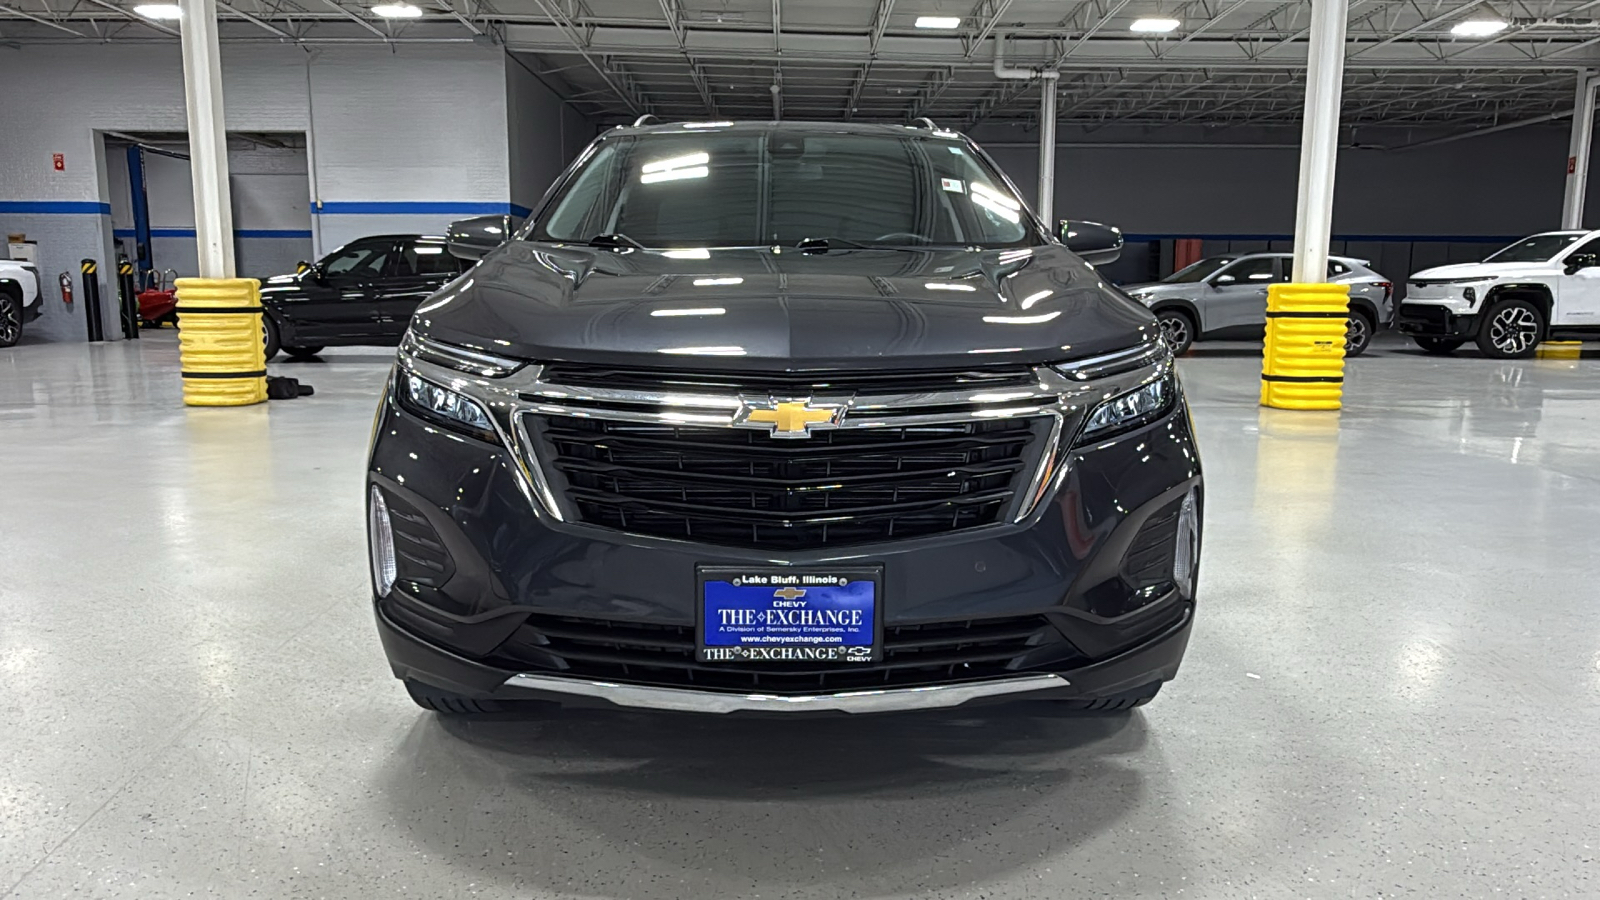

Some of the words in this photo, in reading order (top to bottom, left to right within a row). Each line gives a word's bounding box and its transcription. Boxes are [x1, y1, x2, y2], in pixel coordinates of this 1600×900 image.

[742, 576, 767, 584] Lake
[803, 576, 837, 584] Illinois
[718, 610, 756, 625] THE
[766, 610, 862, 625] EXCHANGE
[741, 635, 842, 644] www.chevyexchange.com
[704, 649, 734, 659] THE
[750, 648, 837, 659] EXCHANGE
